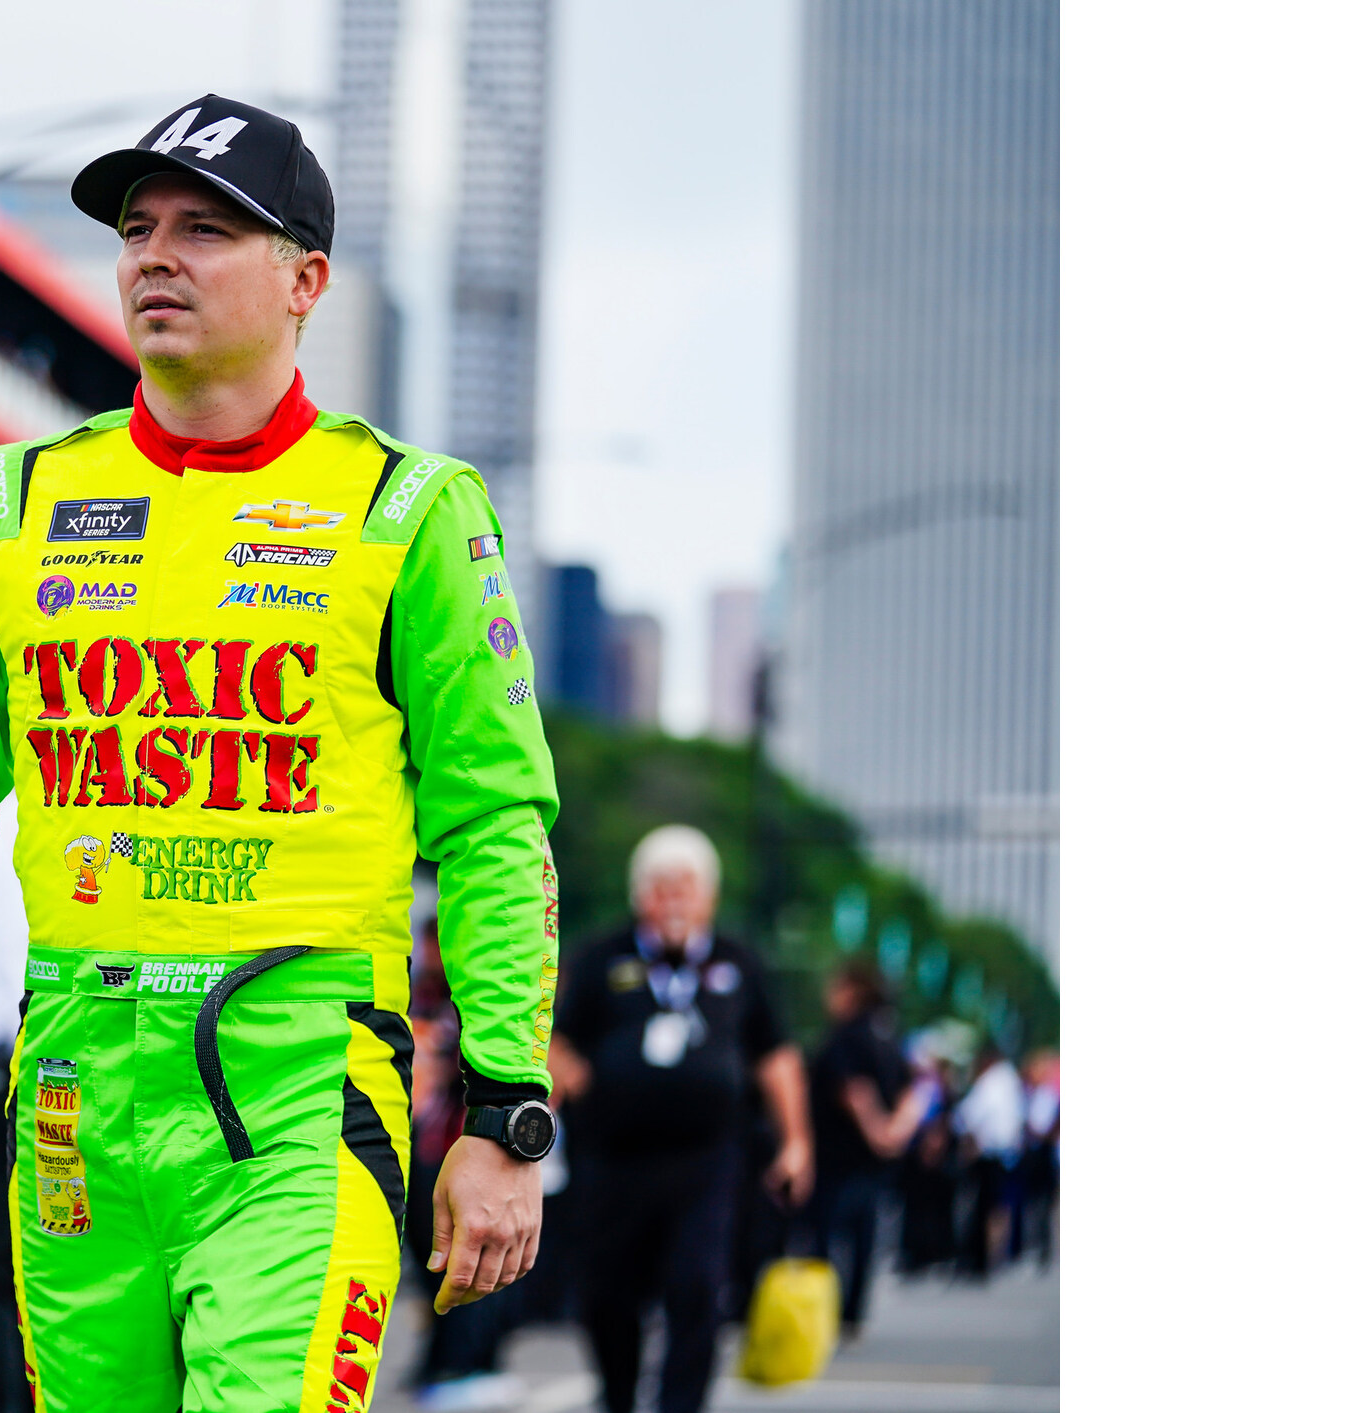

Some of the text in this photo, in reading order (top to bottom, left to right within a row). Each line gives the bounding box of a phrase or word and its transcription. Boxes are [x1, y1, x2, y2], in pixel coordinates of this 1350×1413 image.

[150, 107, 249, 161] 44
[383, 458, 440, 521] sparco
[90, 503, 124, 512] NASCAR
[66, 512, 132, 533] xfinity
[82, 528, 110, 537] SERIES
[41, 551, 144, 567] GOODYEAR
[257, 551, 332, 566] RACING
[78, 582, 137, 597] MAD
[261, 584, 330, 608] Macc
[291, 605, 329, 615] SYSTEMS
[23, 635, 320, 725] TOXIC
[26, 724, 322, 814] WASTE
[129, 834, 274, 870] ENERGY
[141, 867, 257, 904] DRINK
[140, 962, 226, 976] BRENNAN
[136, 975, 222, 993] POOLE
[39, 1088, 76, 1110] TOXIC
[37, 1119, 73, 1143] WASTE
